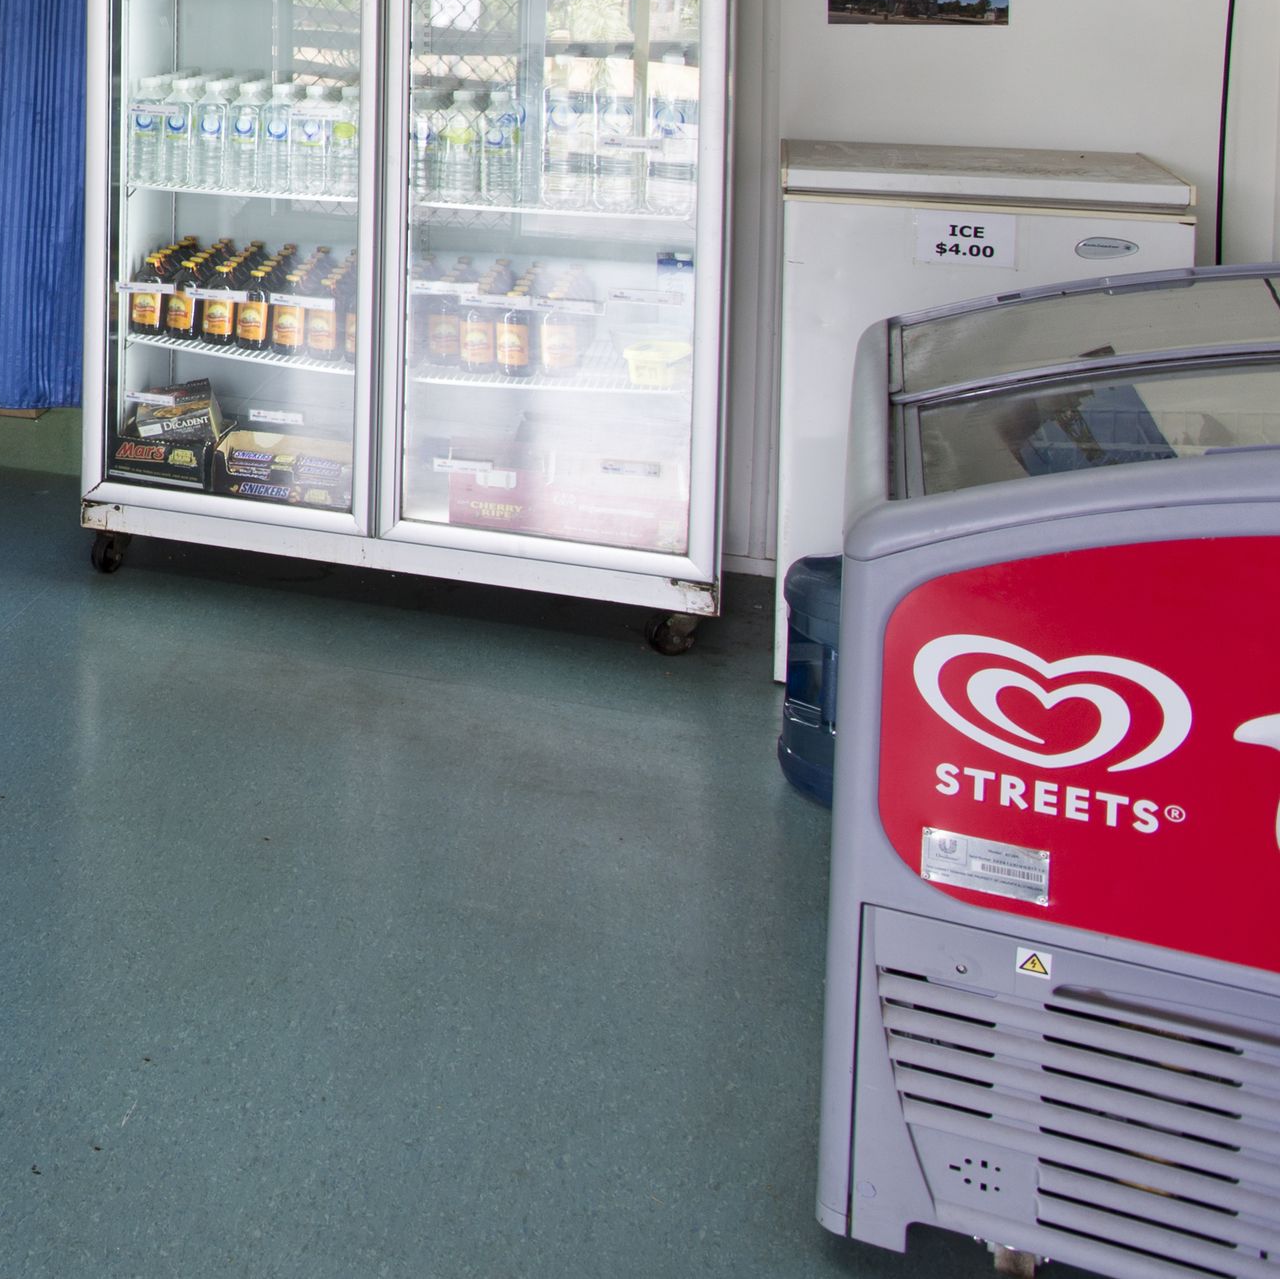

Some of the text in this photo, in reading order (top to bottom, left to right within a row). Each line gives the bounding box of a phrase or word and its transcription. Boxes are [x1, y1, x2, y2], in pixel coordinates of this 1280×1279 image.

[948, 224, 985, 239] ICE
[935, 241, 995, 260] $4.00
[116, 441, 166, 460] Mars
[234, 450, 273, 462] SNICKERS
[240, 482, 291, 498] SNICKERS
[470, 500, 524, 513] CHERRY
[481, 509, 512, 519] RIPE
[934, 762, 1160, 834] STREETS
